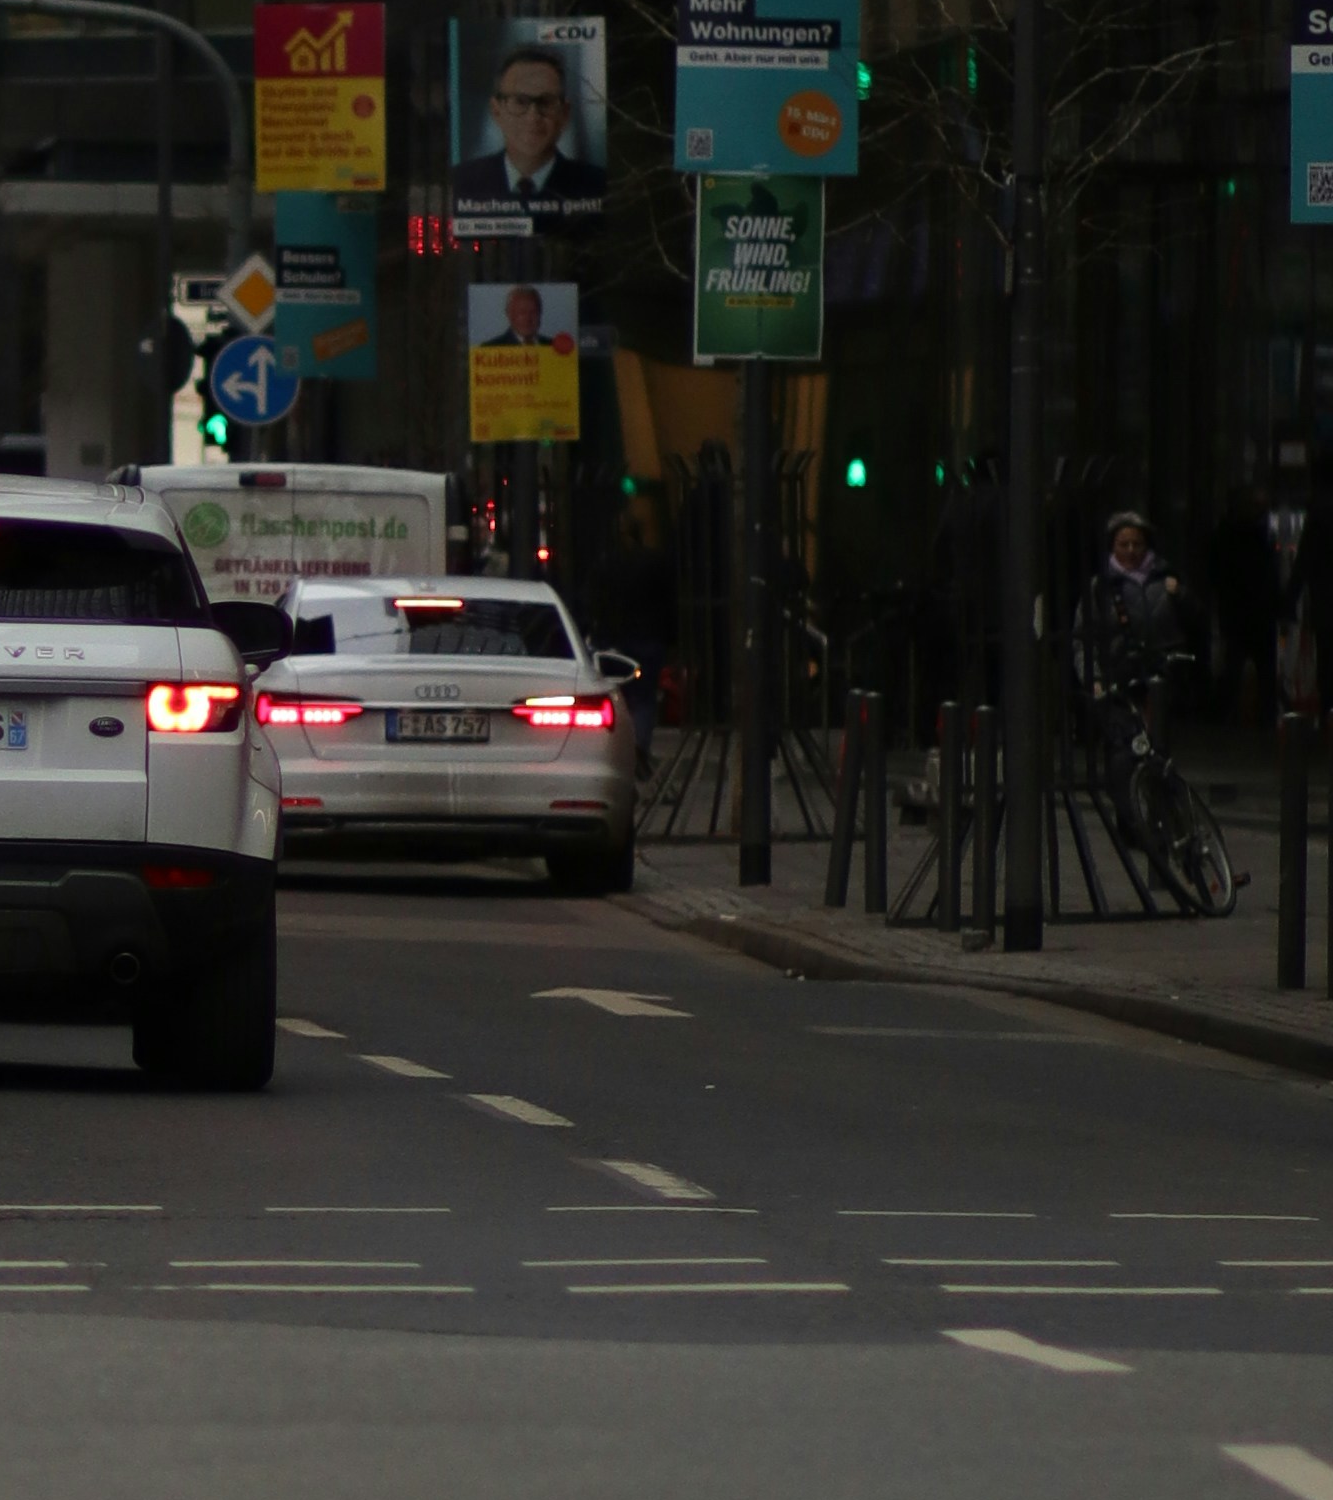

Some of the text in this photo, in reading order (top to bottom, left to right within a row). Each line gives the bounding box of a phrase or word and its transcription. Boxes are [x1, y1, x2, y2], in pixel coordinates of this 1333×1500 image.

[554, 26, 596, 39] CDU
[690, 21, 833, 45] Wohnungen?
[458, 198, 603, 215] Machen, was geht!
[724, 215, 796, 243] SONNE,
[734, 242, 790, 268] WIND,
[705, 266, 812, 294] FRÜHLING!
[240, 513, 408, 541] flaschenpost.de
[215, 557, 371, 576] GETRÄNKELIEFERUNG
[234, 579, 250, 594] IN
[257, 579, 282, 595] 120
